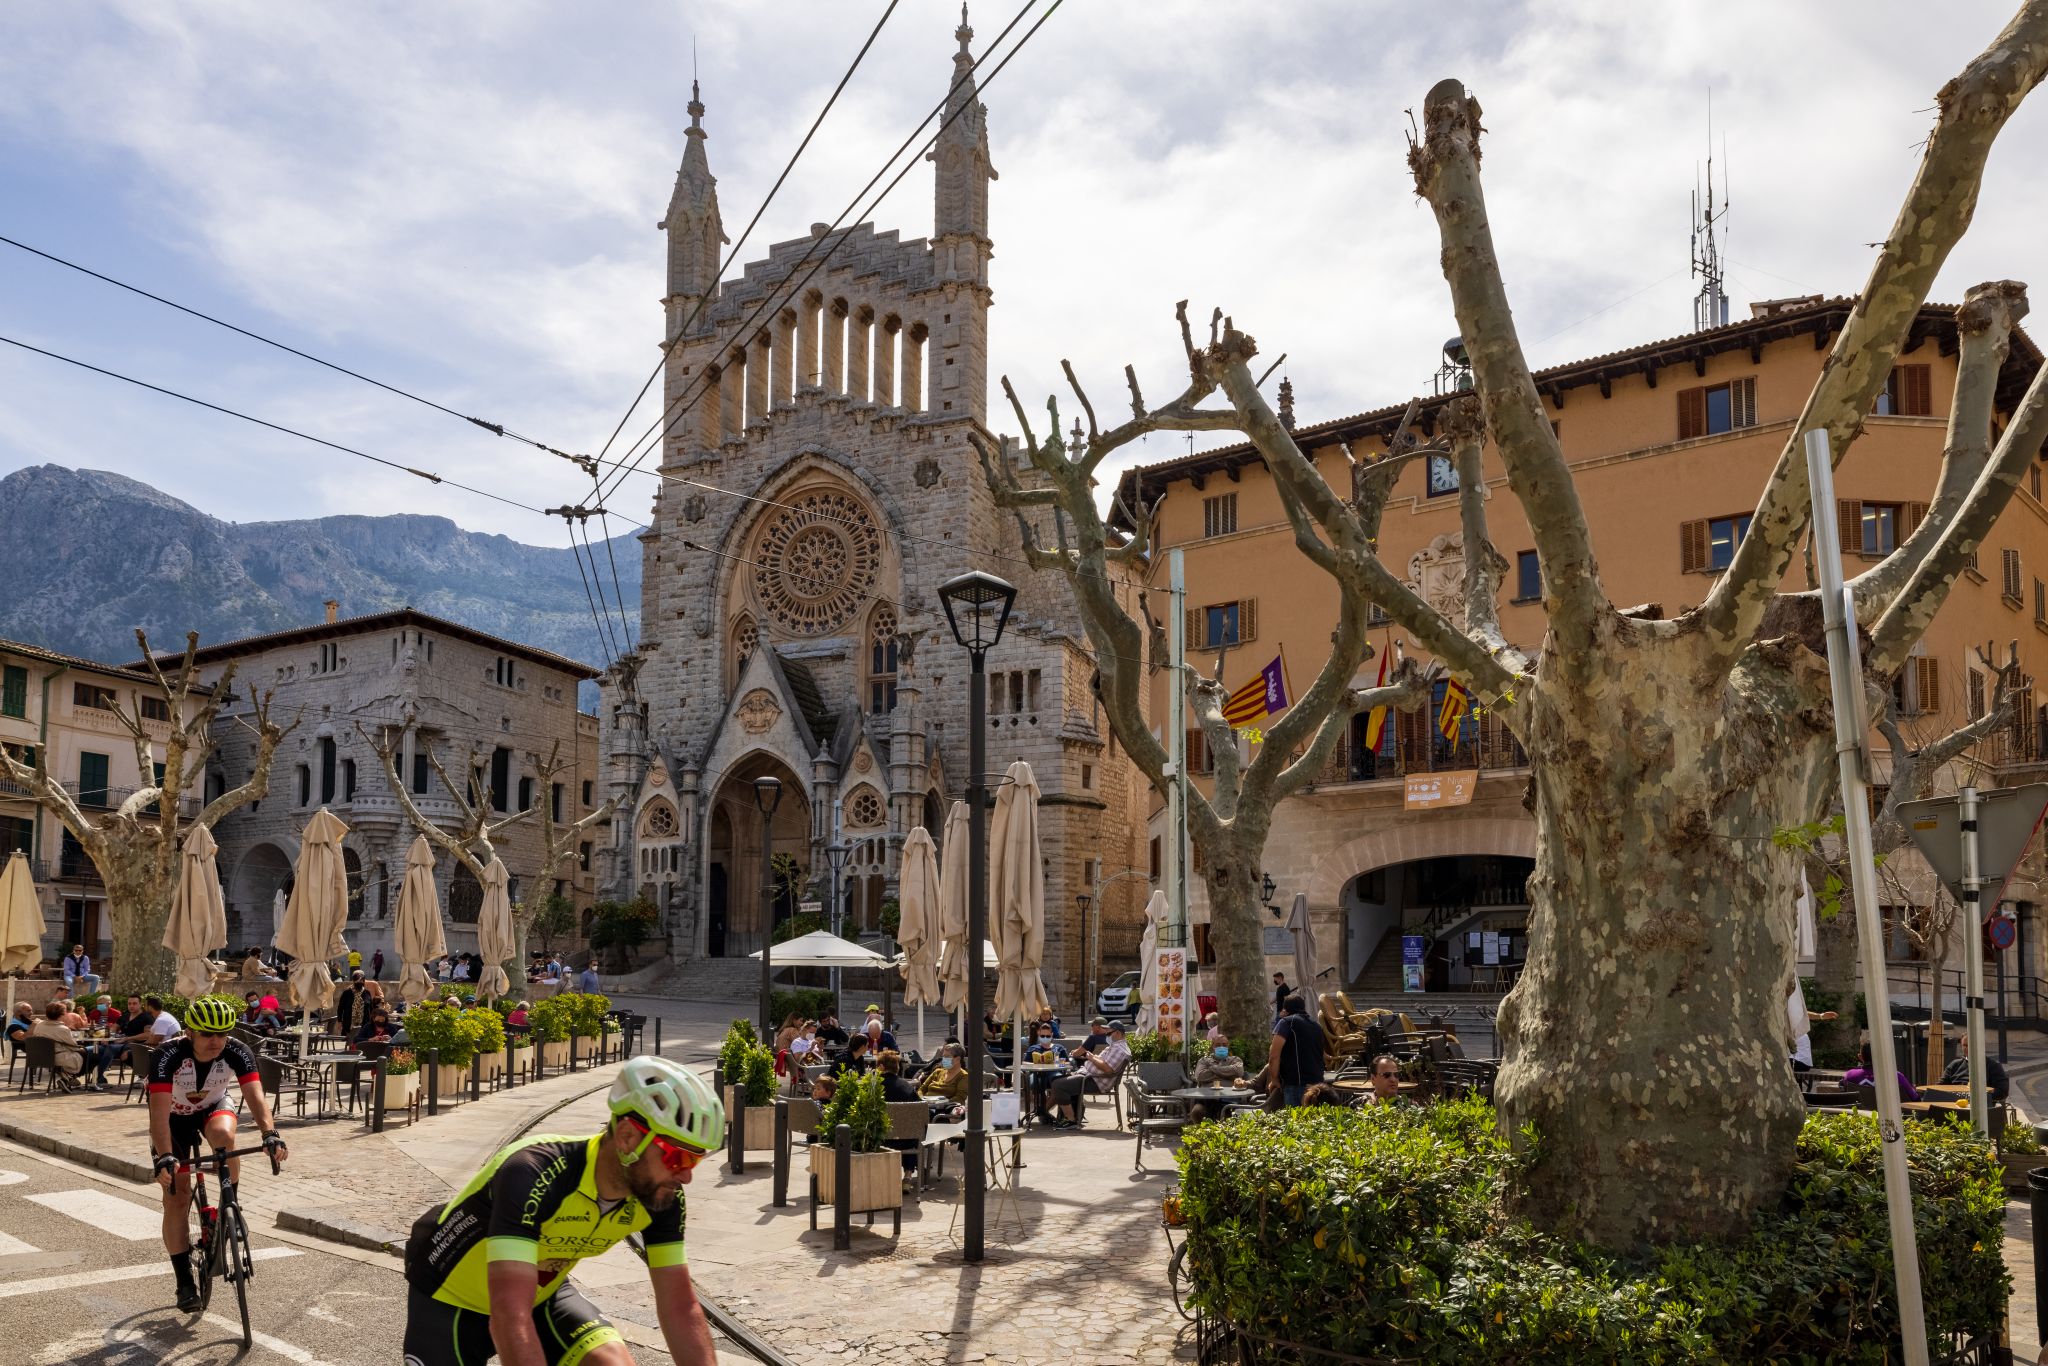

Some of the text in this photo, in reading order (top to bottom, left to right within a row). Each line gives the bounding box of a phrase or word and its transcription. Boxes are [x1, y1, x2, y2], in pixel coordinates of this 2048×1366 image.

[1447, 775, 1472, 784] Nivell
[1455, 784, 1463, 795] 2
[158, 1046, 178, 1078] PORSCHE
[521, 1156, 568, 1227] PORSCHE
[431, 1209, 465, 1245] VOLKSWAGEN
[554, 1215, 591, 1224] GARMIN
[428, 1231, 457, 1265] FINANCIAL
[453, 1214, 478, 1236] SERVICES
[539, 1233, 621, 1248] PORSCH
